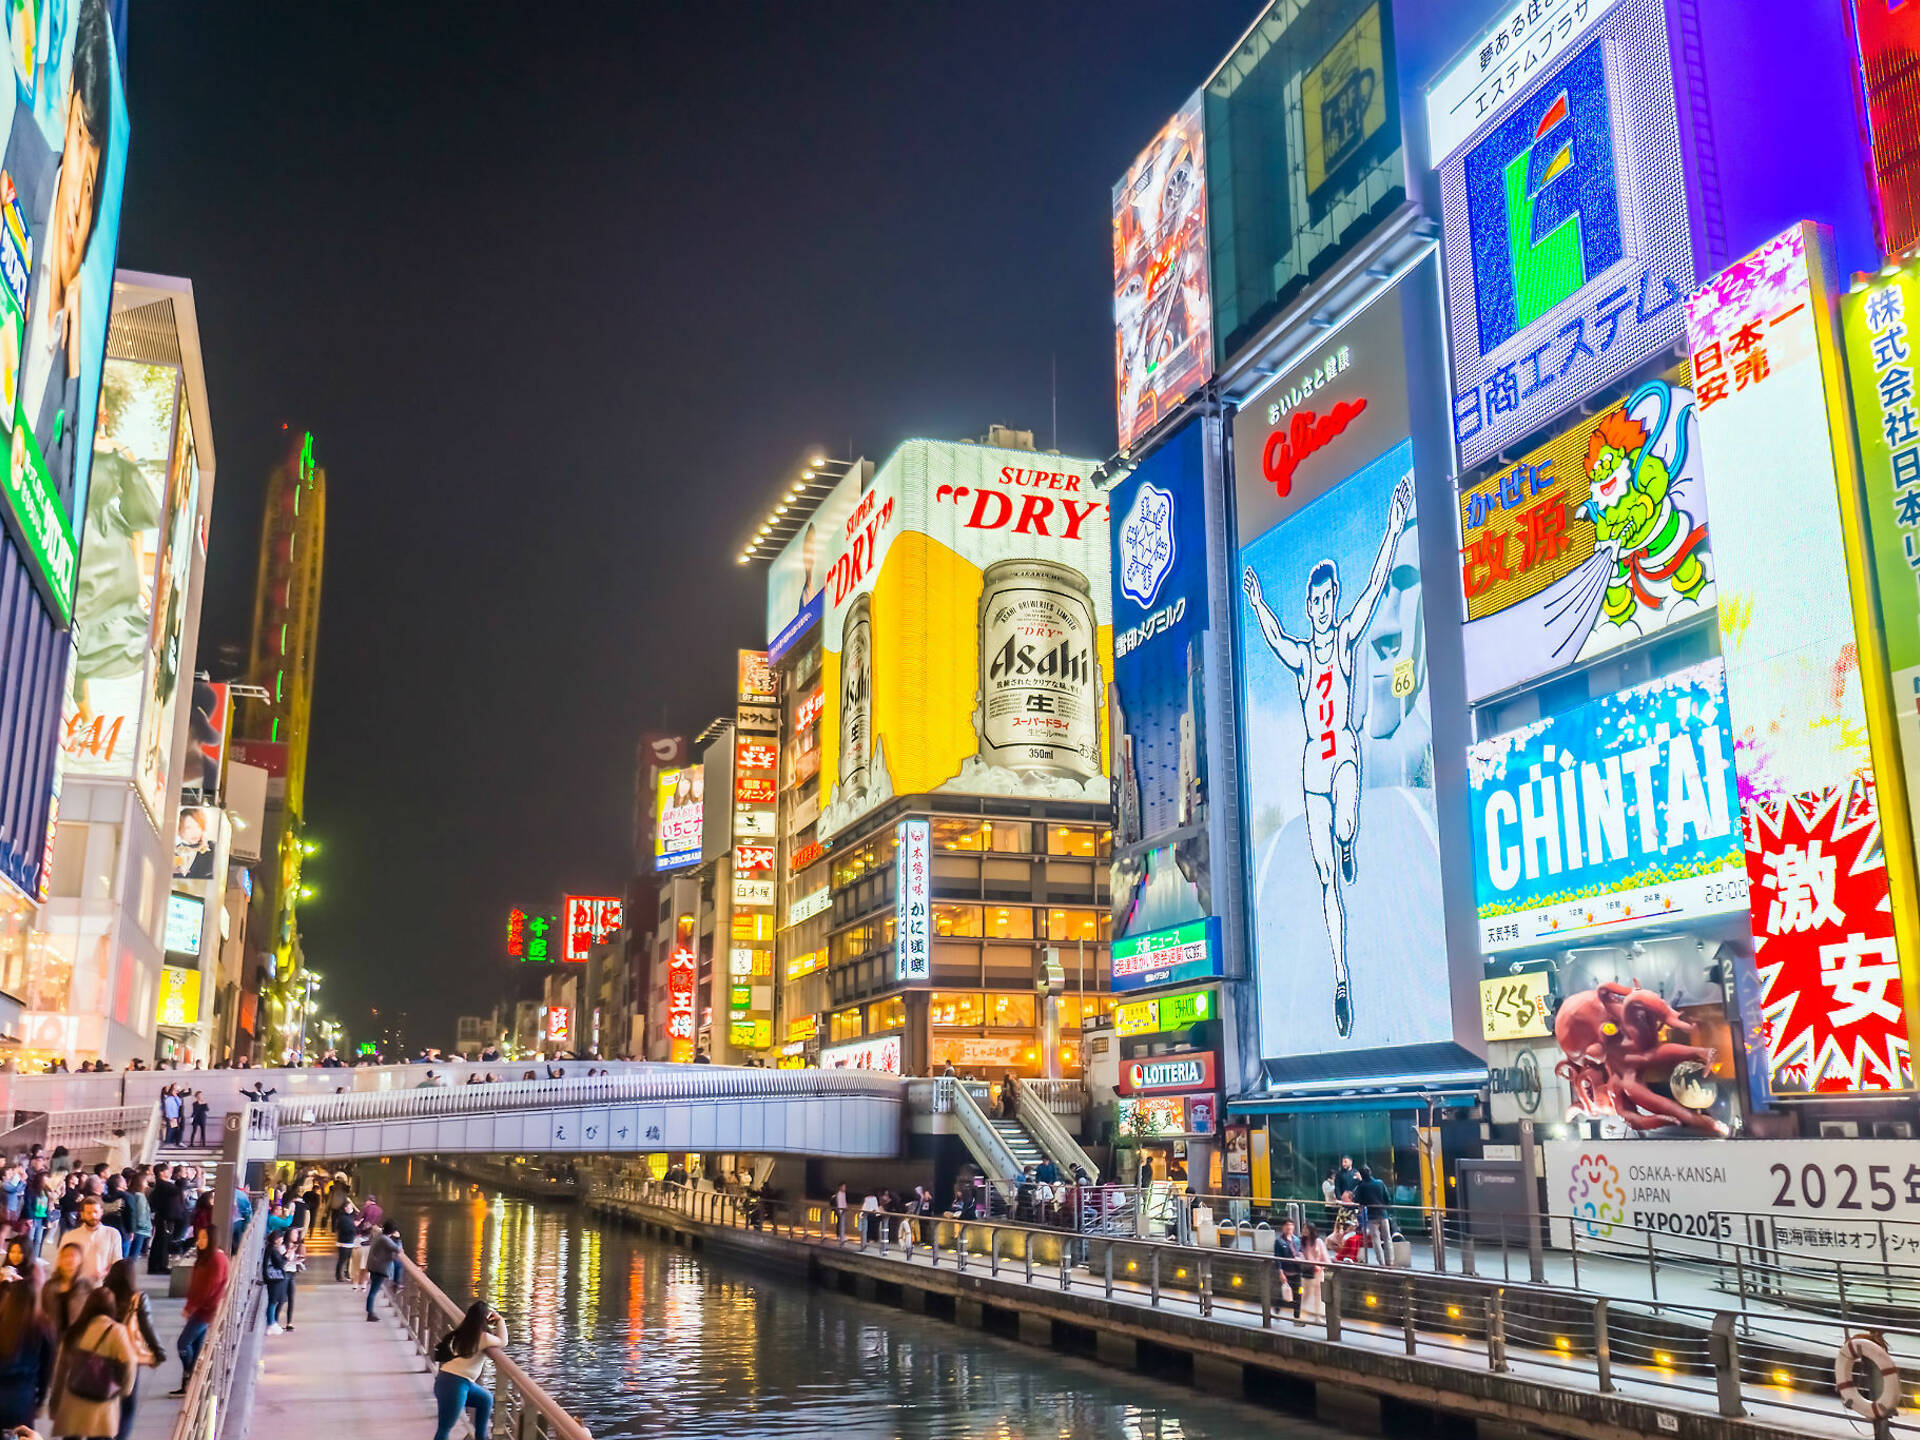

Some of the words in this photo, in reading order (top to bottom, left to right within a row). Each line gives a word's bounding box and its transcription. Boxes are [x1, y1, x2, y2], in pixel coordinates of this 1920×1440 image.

[1692, 303, 1806, 381] 日本一
[1452, 268, 1683, 446] 日商エステム
[1266, 345, 1352, 426] おいしさと健康
[999, 465, 1082, 494] SUPER
[1465, 459, 1555, 530] かぜに
[845, 488, 876, 541] SUPER
[1459, 491, 1571, 600] 改源
[1000, 607, 1017, 624] ASAHI
[1055, 608, 1078, 631] LIMITED
[1115, 596, 1186, 660] 雪印メグミルク
[988, 634, 1088, 688] Asahi
[1395, 673, 1411, 693] 66
[1026, 693, 1056, 714] 生
[1315, 663, 1338, 762] グリコ
[1012, 717, 1070, 730] スーパードライ
[1028, 748, 1054, 760] 350ml
[1484, 717, 1732, 892] CHINTAI
[737, 849, 773, 869] はや
[911, 846, 925, 897] 本場の味
[737, 884, 770, 898] 白木屋
[1706, 879, 1749, 904] 22:00
[910, 901, 926, 974] かに道楽
[1135, 930, 1181, 955] 大阪ニュース
[1487, 922, 1520, 944] 天気予報
[1762, 839, 1903, 1029] 激安
[1722, 960, 1735, 1003] 2F
[1494, 983, 1536, 1029] くくる
[1143, 1060, 1200, 1085] LOTTERIA
[554, 1123, 662, 1143] えびす橋
[1628, 1164, 1727, 1184] OSAKA-KANSAI
[1631, 1186, 1672, 1205] JAPAN
[1632, 1210, 1733, 1239] EXPO2025
